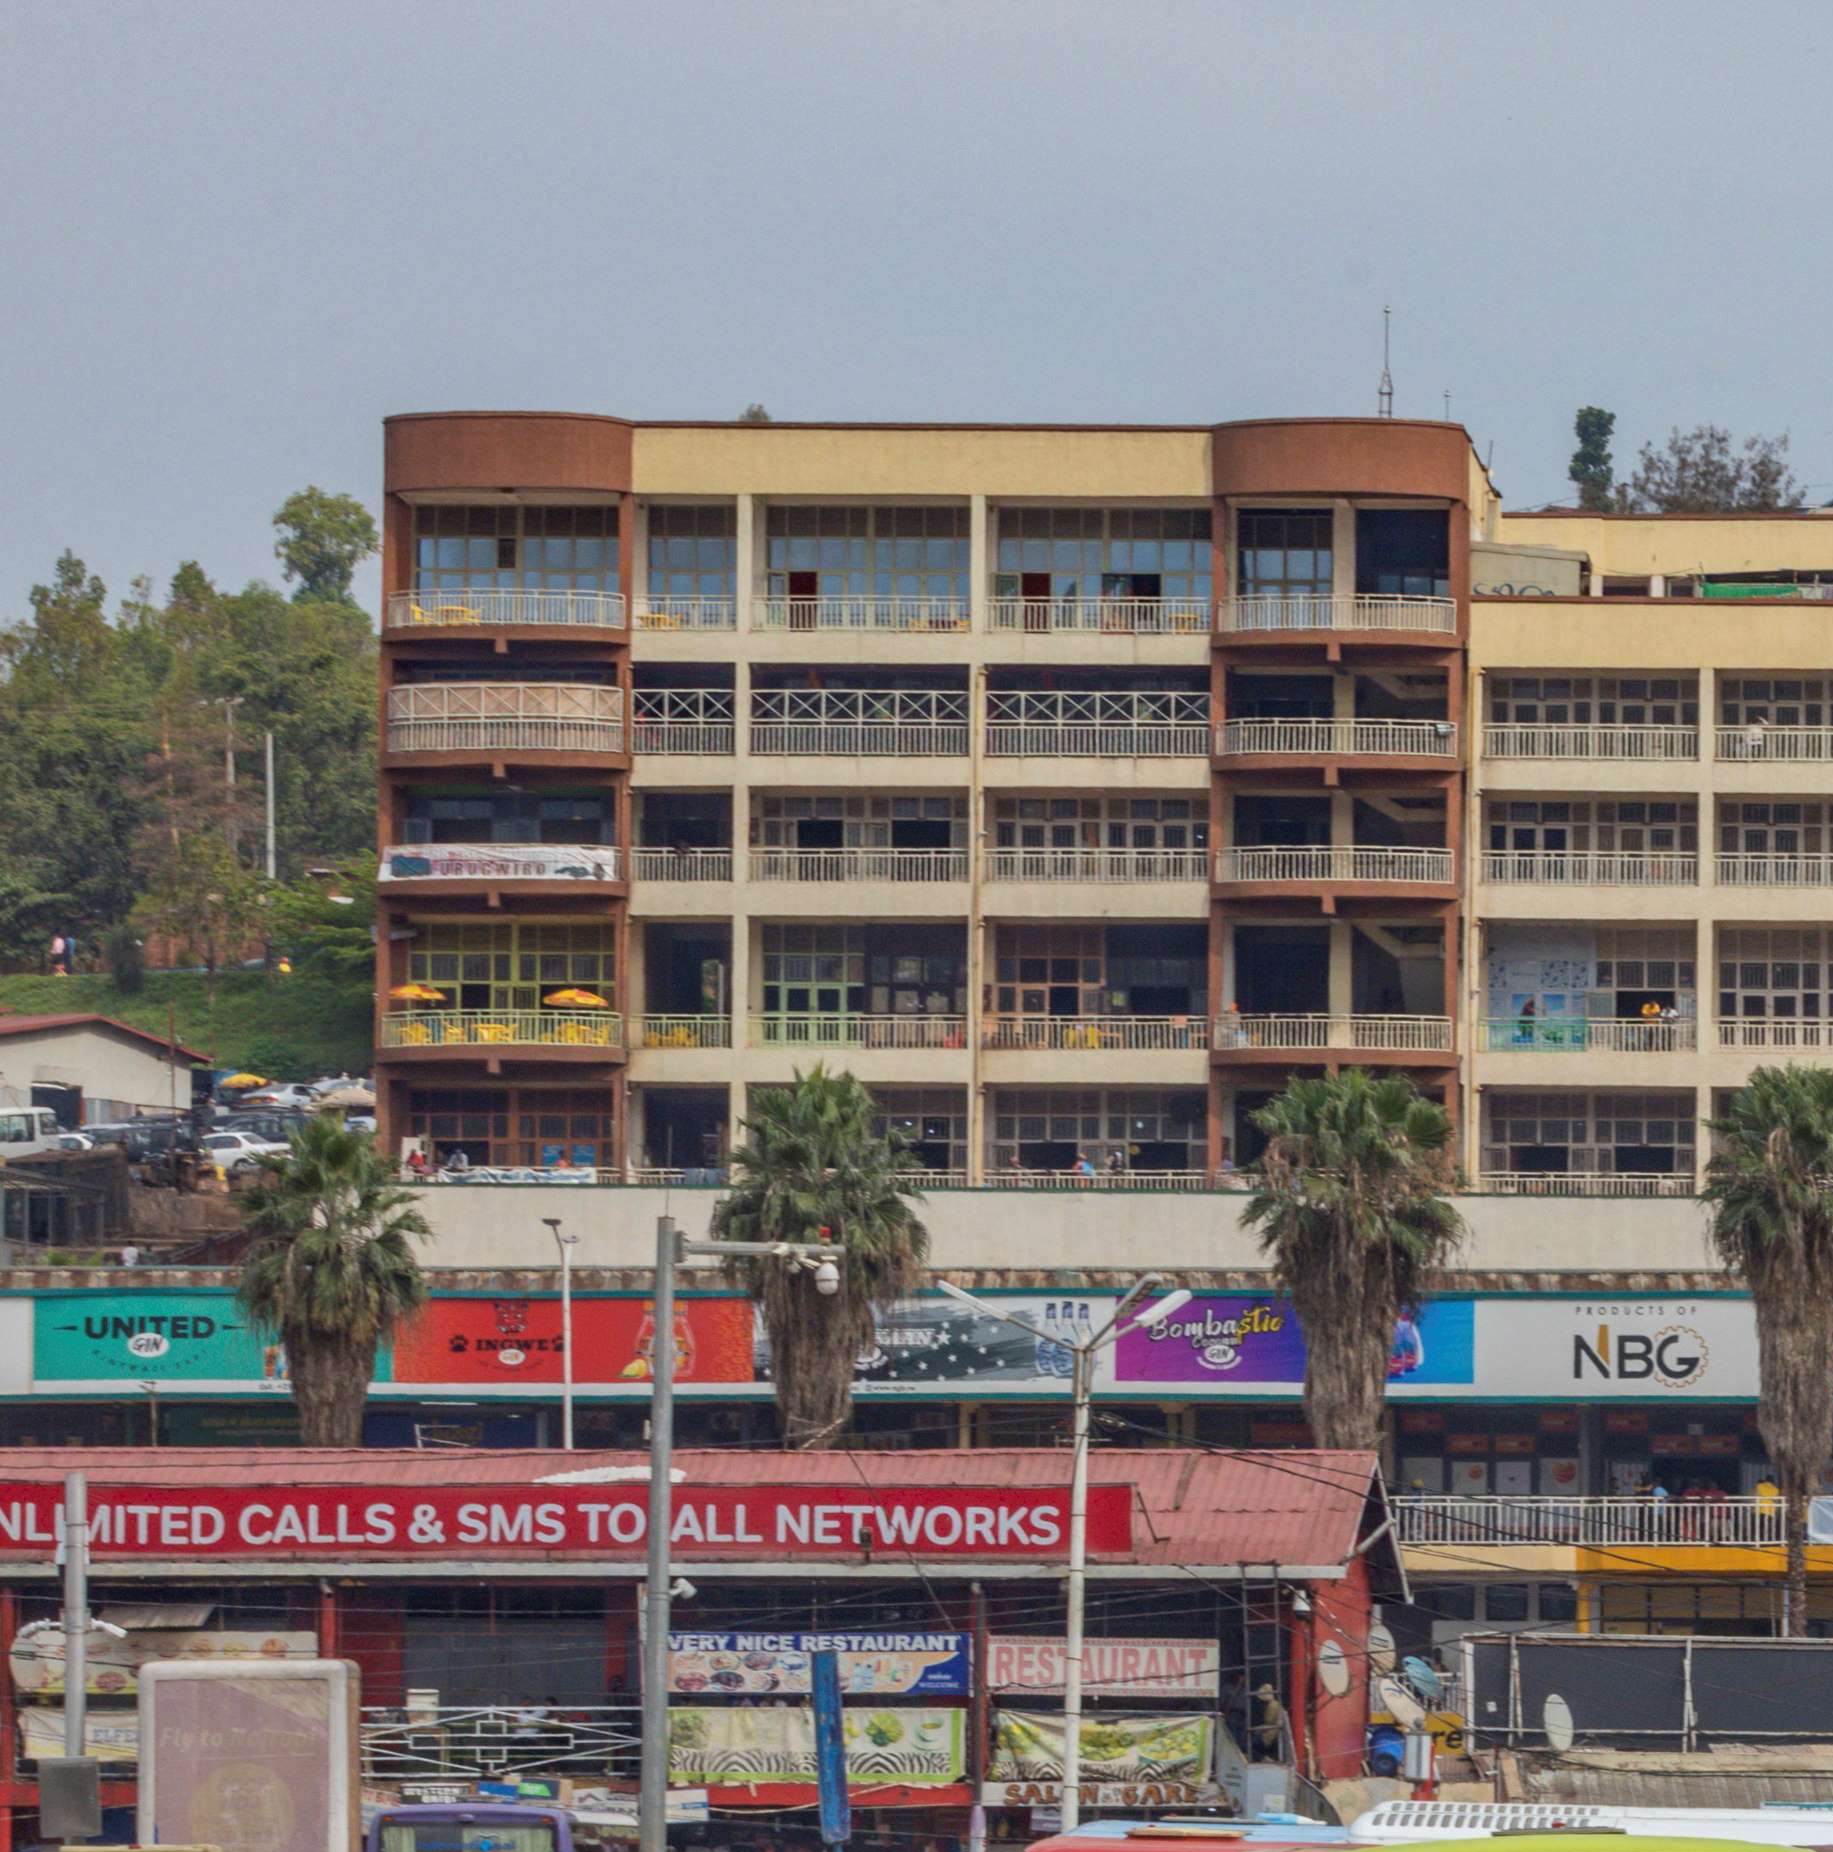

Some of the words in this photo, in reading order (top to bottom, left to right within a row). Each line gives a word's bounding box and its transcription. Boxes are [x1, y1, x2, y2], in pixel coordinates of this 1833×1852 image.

[1576, 1306, 1665, 1316] PRODUCTS
[1677, 1306, 1697, 1316] OF
[85, 1316, 215, 1340] UNITED
[1150, 1306, 1283, 1346] Bombastic
[131, 1335, 165, 1354] GIN
[475, 1338, 549, 1352] INGWE
[1574, 1325, 1701, 1380] NBG
[0, 1503, 225, 1545] NLIMITED
[238, 1504, 396, 1545] CALLS
[407, 1504, 446, 1544] &
[457, 1503, 566, 1543] SMS
[577, 1504, 646, 1543] TO
[670, 1504, 762, 1544] ALL
[776, 1504, 1061, 1546] NETWORKS
[668, 1635, 729, 1652] VERY
[737, 1635, 796, 1652] NICE
[801, 1635, 961, 1652] RESTAURANT
[994, 1646, 1206, 1688] RESAURANT
[1004, 1783, 1099, 1806] SALN
